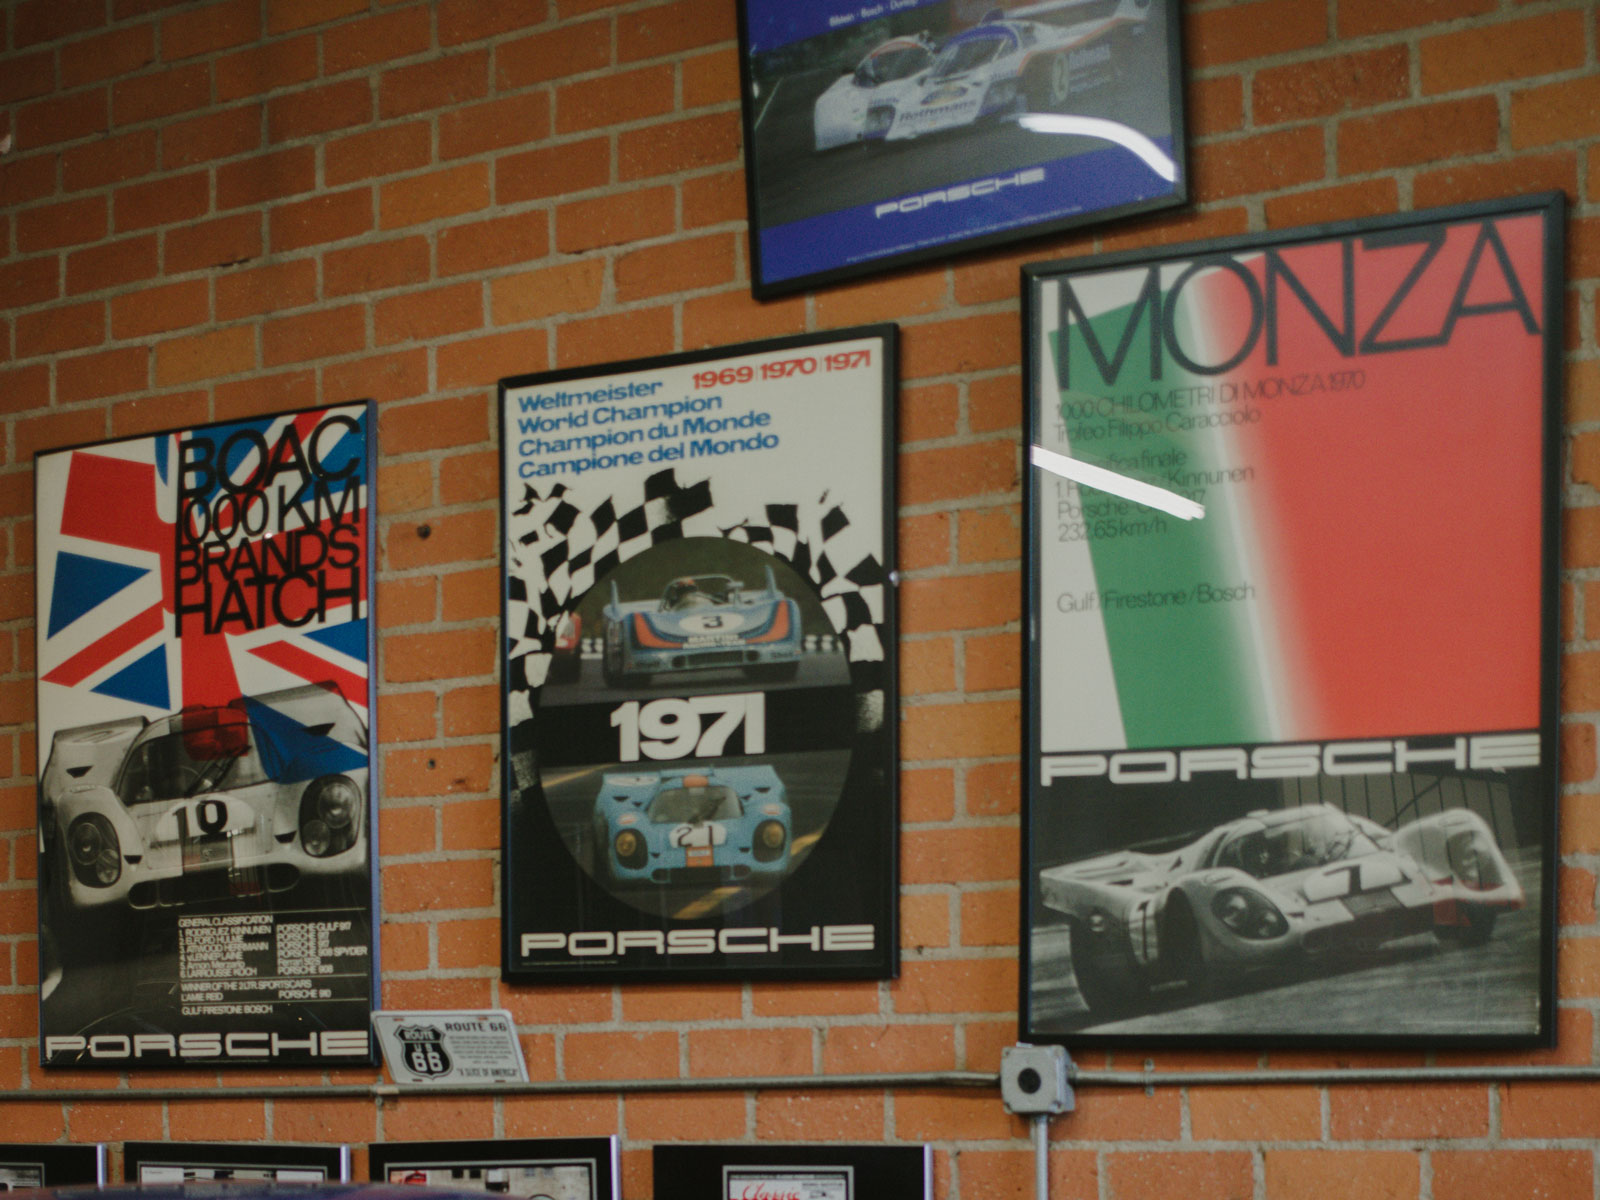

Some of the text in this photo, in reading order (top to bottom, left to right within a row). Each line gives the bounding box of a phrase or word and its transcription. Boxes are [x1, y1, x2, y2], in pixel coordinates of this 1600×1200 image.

[875, 168, 1045, 219] PORSCHE
[1058, 219, 1542, 390] MONZA
[692, 350, 871, 390] 1969 1970 1971
[517, 381, 663, 413] Weltmeister
[1096, 386, 1214, 417] CHILOMETRI
[1243, 374, 1326, 402] MONZA
[1328, 370, 1366, 392] 1970
[517, 395, 723, 435] World Champion
[517, 410, 771, 457] Champion du Monde
[1108, 417, 1164, 441] Filippo
[1166, 408, 1261, 433] Caracciolo
[178, 415, 362, 498] BOAC
[517, 432, 779, 479] Campione del Mondo
[1141, 448, 1188, 468] finale
[278, 475, 361, 533] KM
[176, 524, 361, 586] BRANDS
[175, 566, 361, 638] HATCH
[702, 615, 724, 629] 3
[610, 691, 766, 763] 1971
[1040, 733, 1541, 787] PORSCHE
[172, 799, 229, 839] 10
[676, 825, 714, 848] 21
[520, 924, 876, 958] PORSCHE
[45, 1030, 369, 1060] PORSCHE
[404, 1030, 435, 1040] ROUTE
[445, 1022, 507, 1032] ROUTE 66
[411, 1052, 444, 1072] 66
